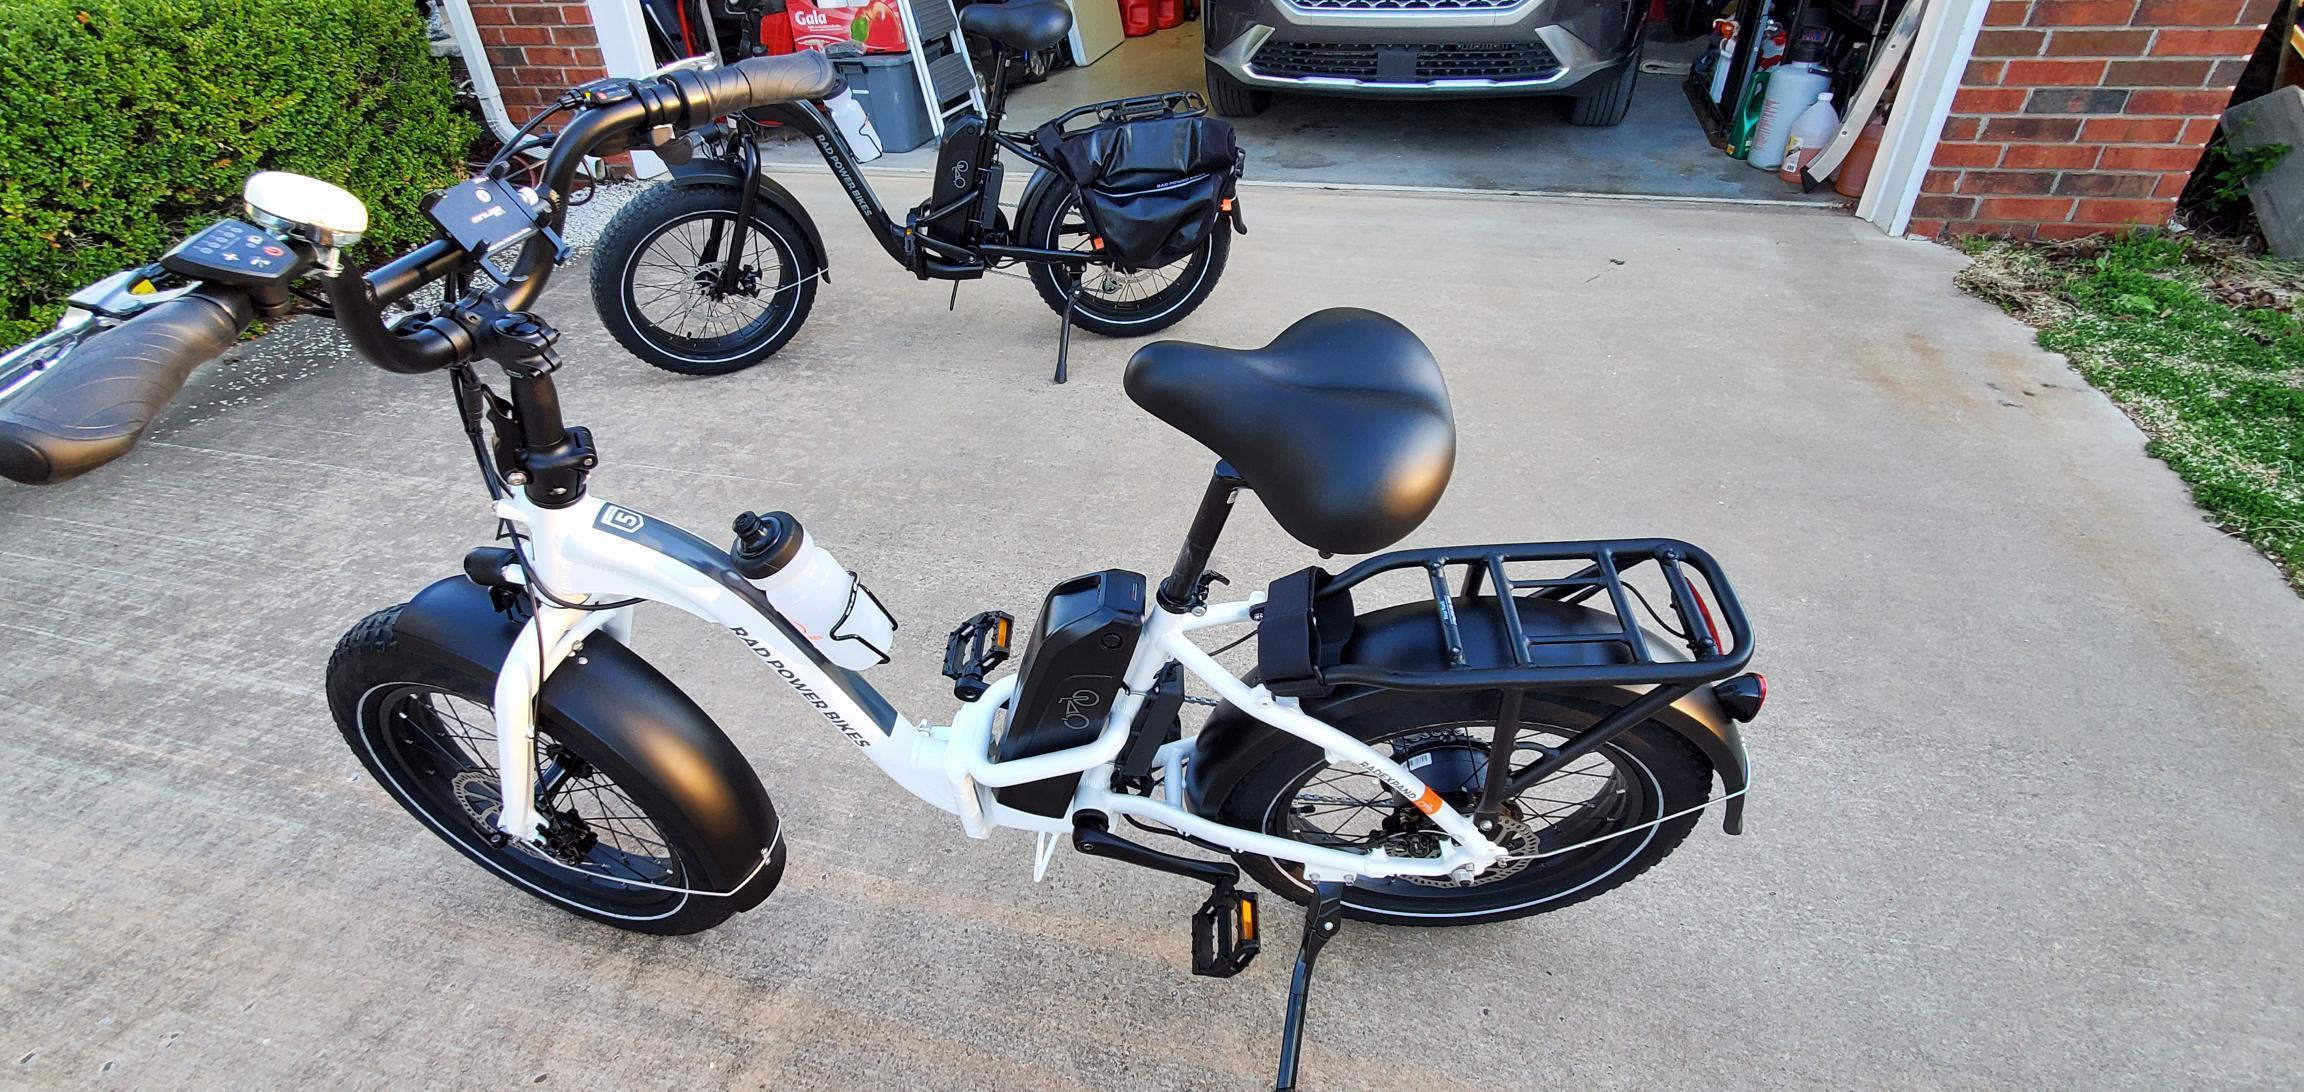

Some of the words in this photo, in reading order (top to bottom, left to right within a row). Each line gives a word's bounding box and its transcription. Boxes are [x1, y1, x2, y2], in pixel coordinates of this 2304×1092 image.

[795, 10, 828, 25] Gala
[816, 134, 834, 156] RAD
[830, 155, 857, 190] POWER
[852, 188, 873, 217] BIKES
[615, 511, 638, 527] 5
[729, 626, 771, 658] RAD
[766, 660, 829, 709] POWER
[823, 711, 871, 748] BIKES
[1358, 761, 1417, 799] RADEXPAND
